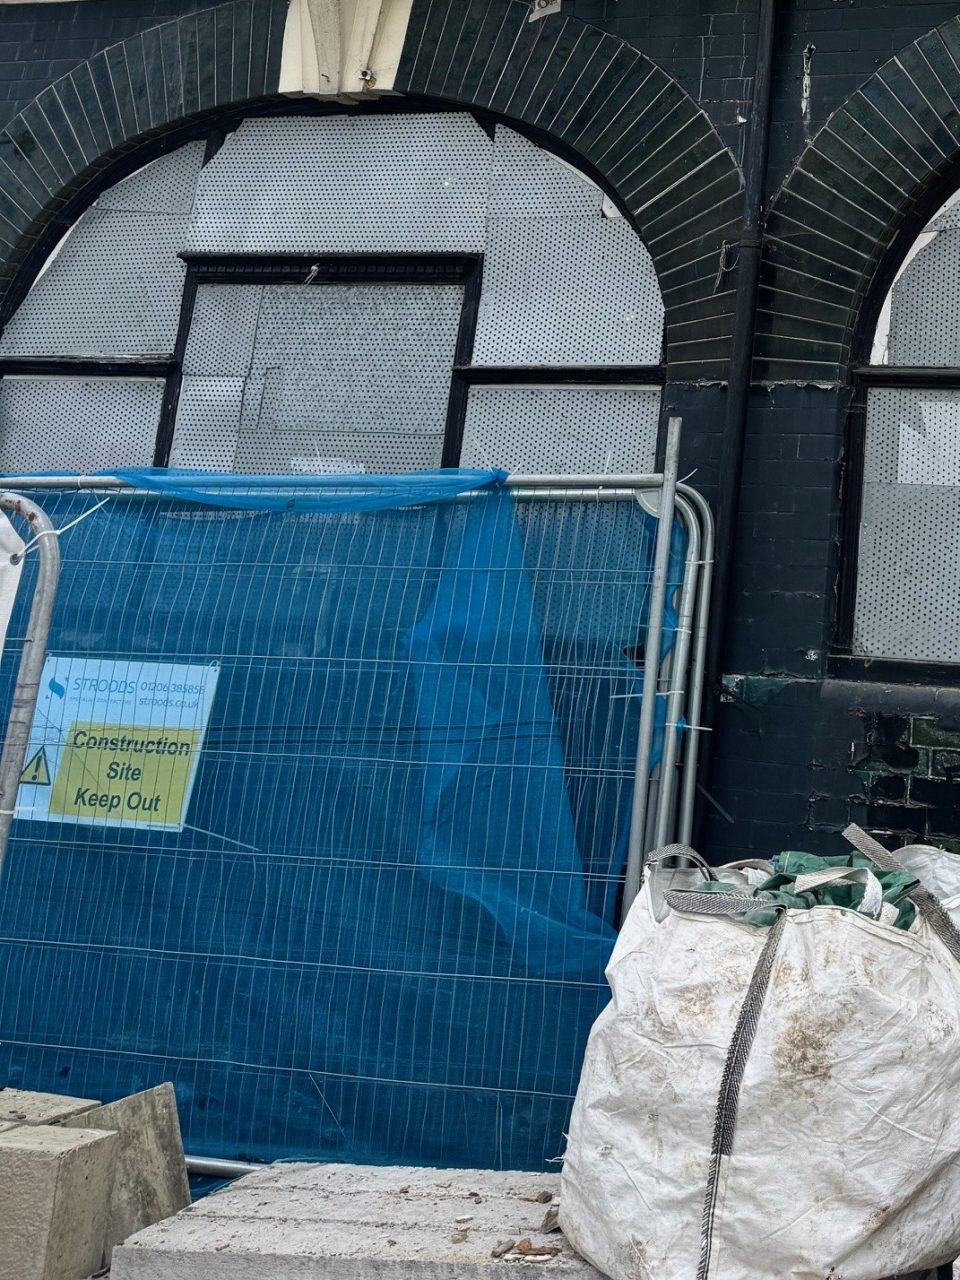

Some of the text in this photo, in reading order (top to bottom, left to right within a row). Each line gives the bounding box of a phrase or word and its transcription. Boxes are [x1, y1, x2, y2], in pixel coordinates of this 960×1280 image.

[72, 677, 136, 694] STROODS
[73, 730, 192, 756] Construction
[106, 761, 142, 781] Site
[74, 787, 161, 812] Keep Out
